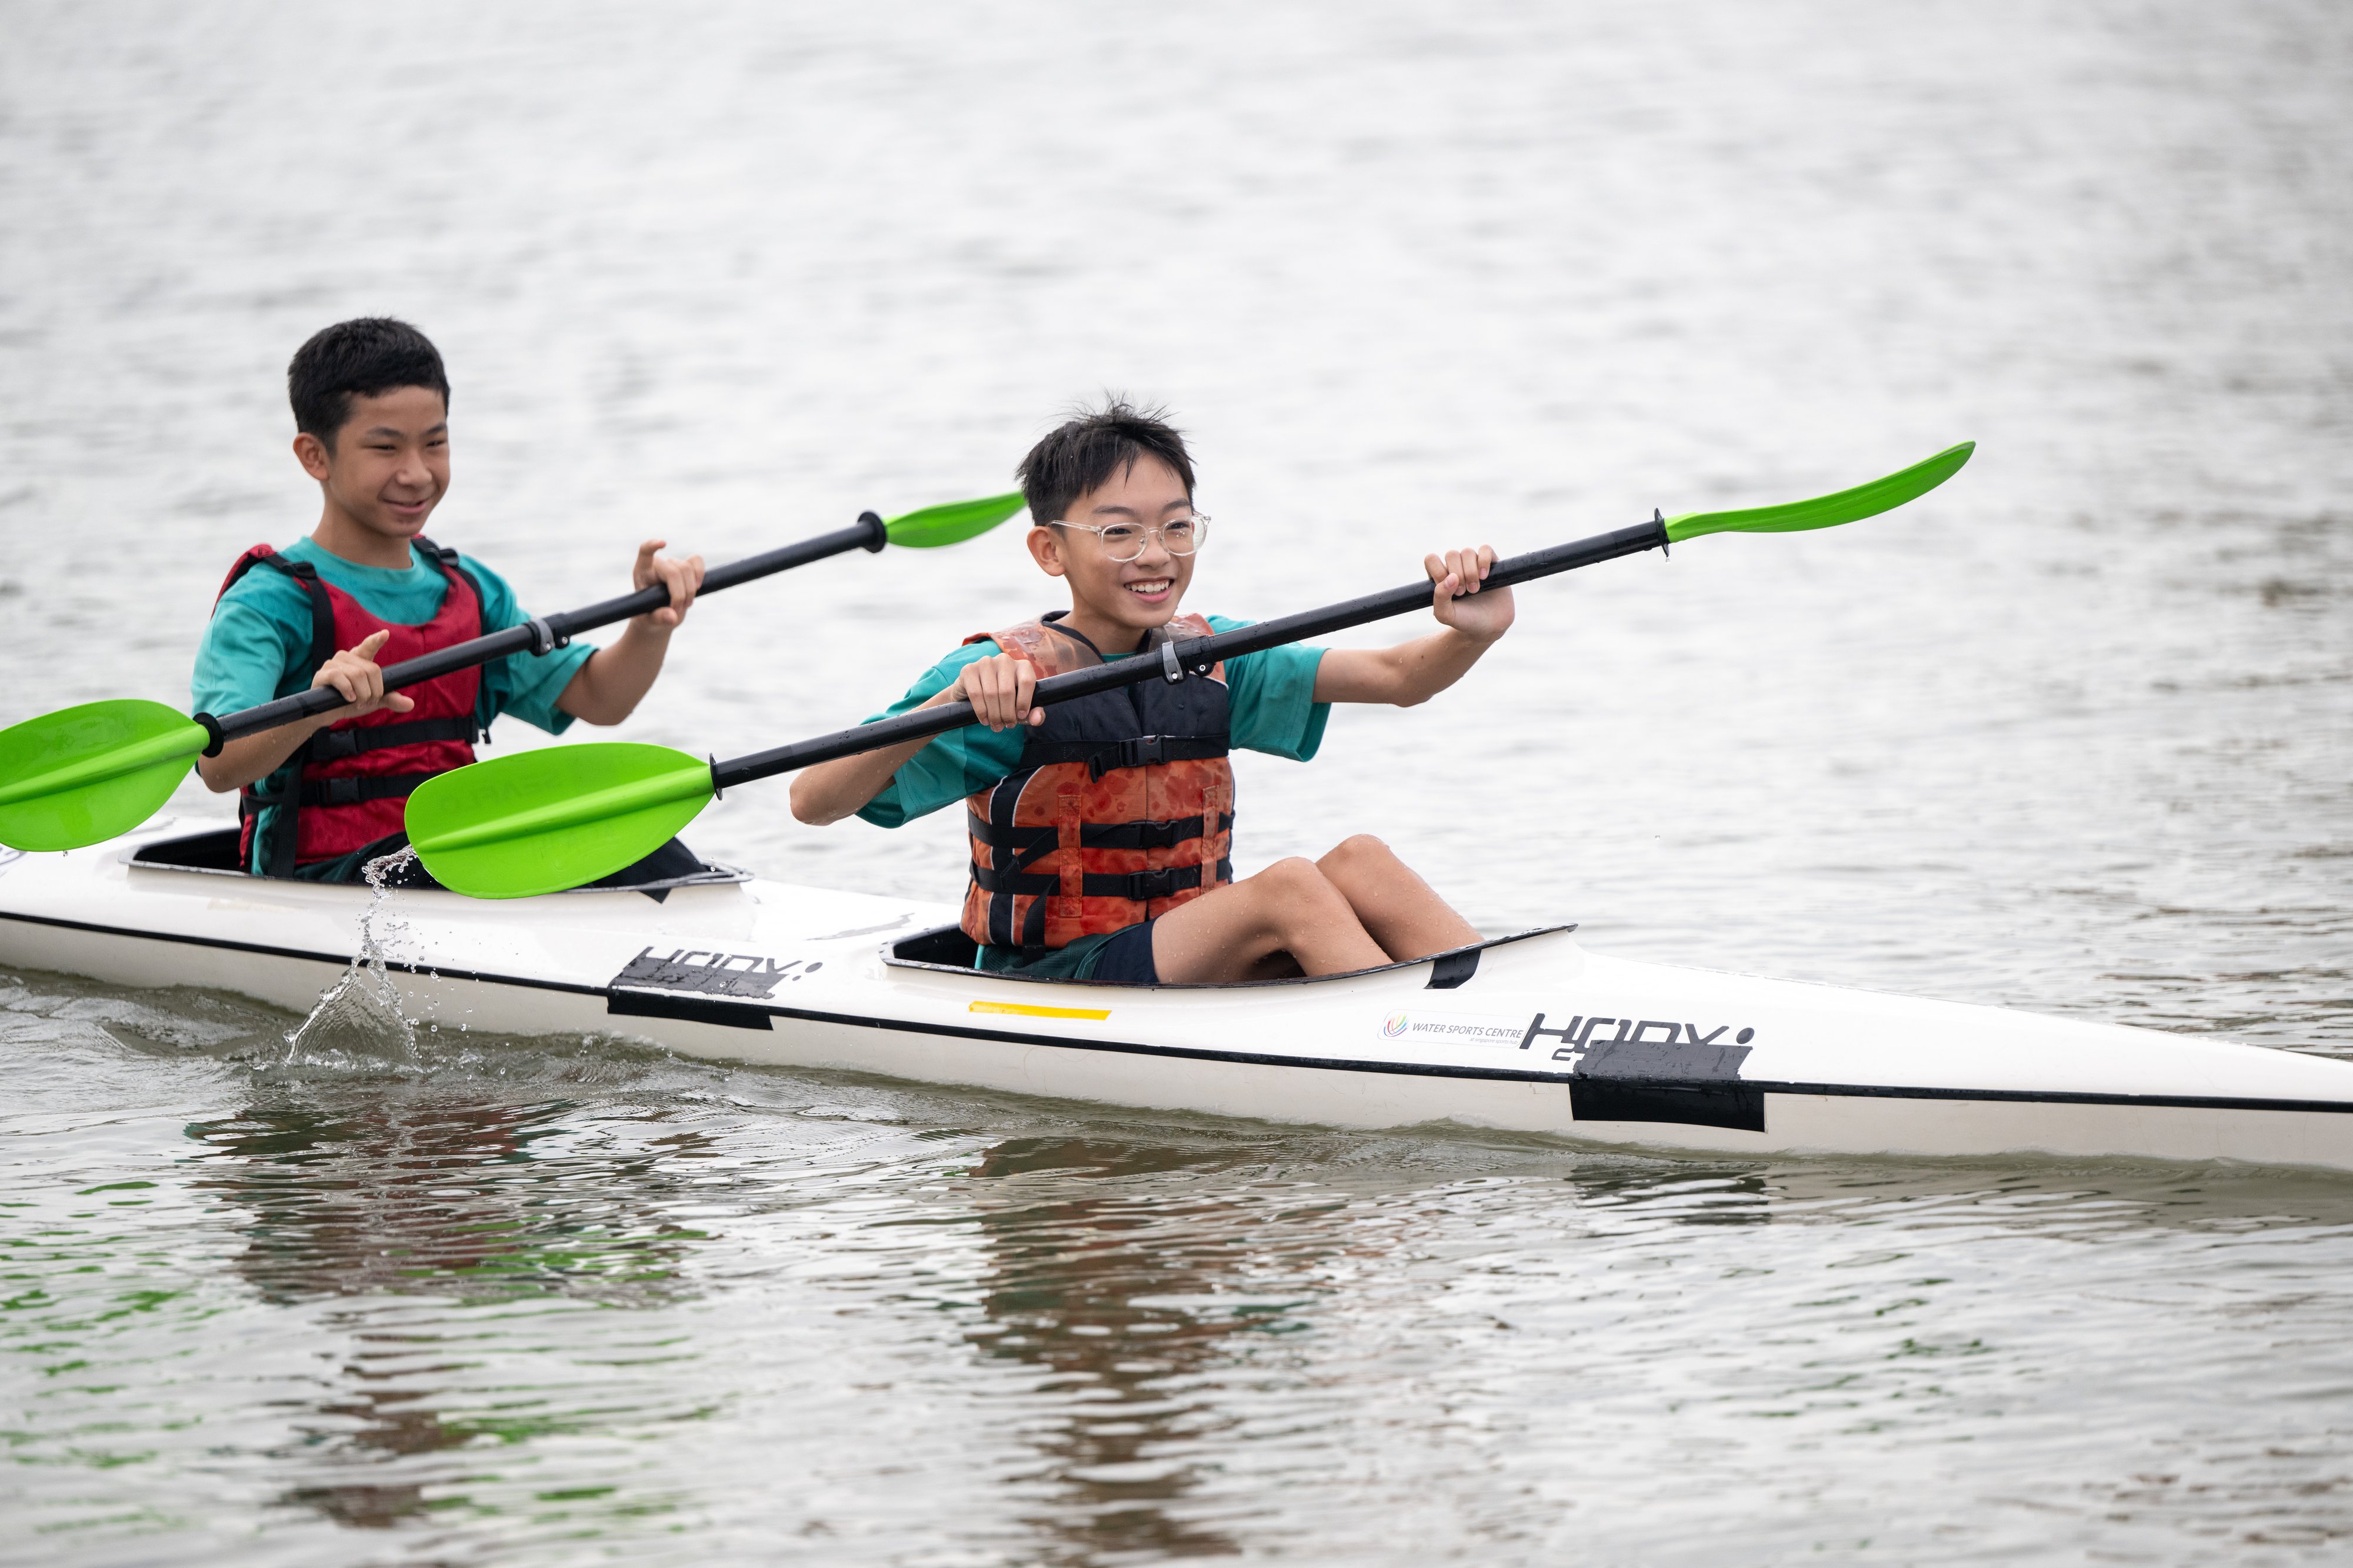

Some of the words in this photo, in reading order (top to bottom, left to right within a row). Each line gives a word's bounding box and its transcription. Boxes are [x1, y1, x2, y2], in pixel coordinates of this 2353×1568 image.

[1412, 1023, 1446, 1033] WATER
[1447, 1025, 1484, 1036] SPORTS
[1485, 1027, 1524, 1038] CENTRE
